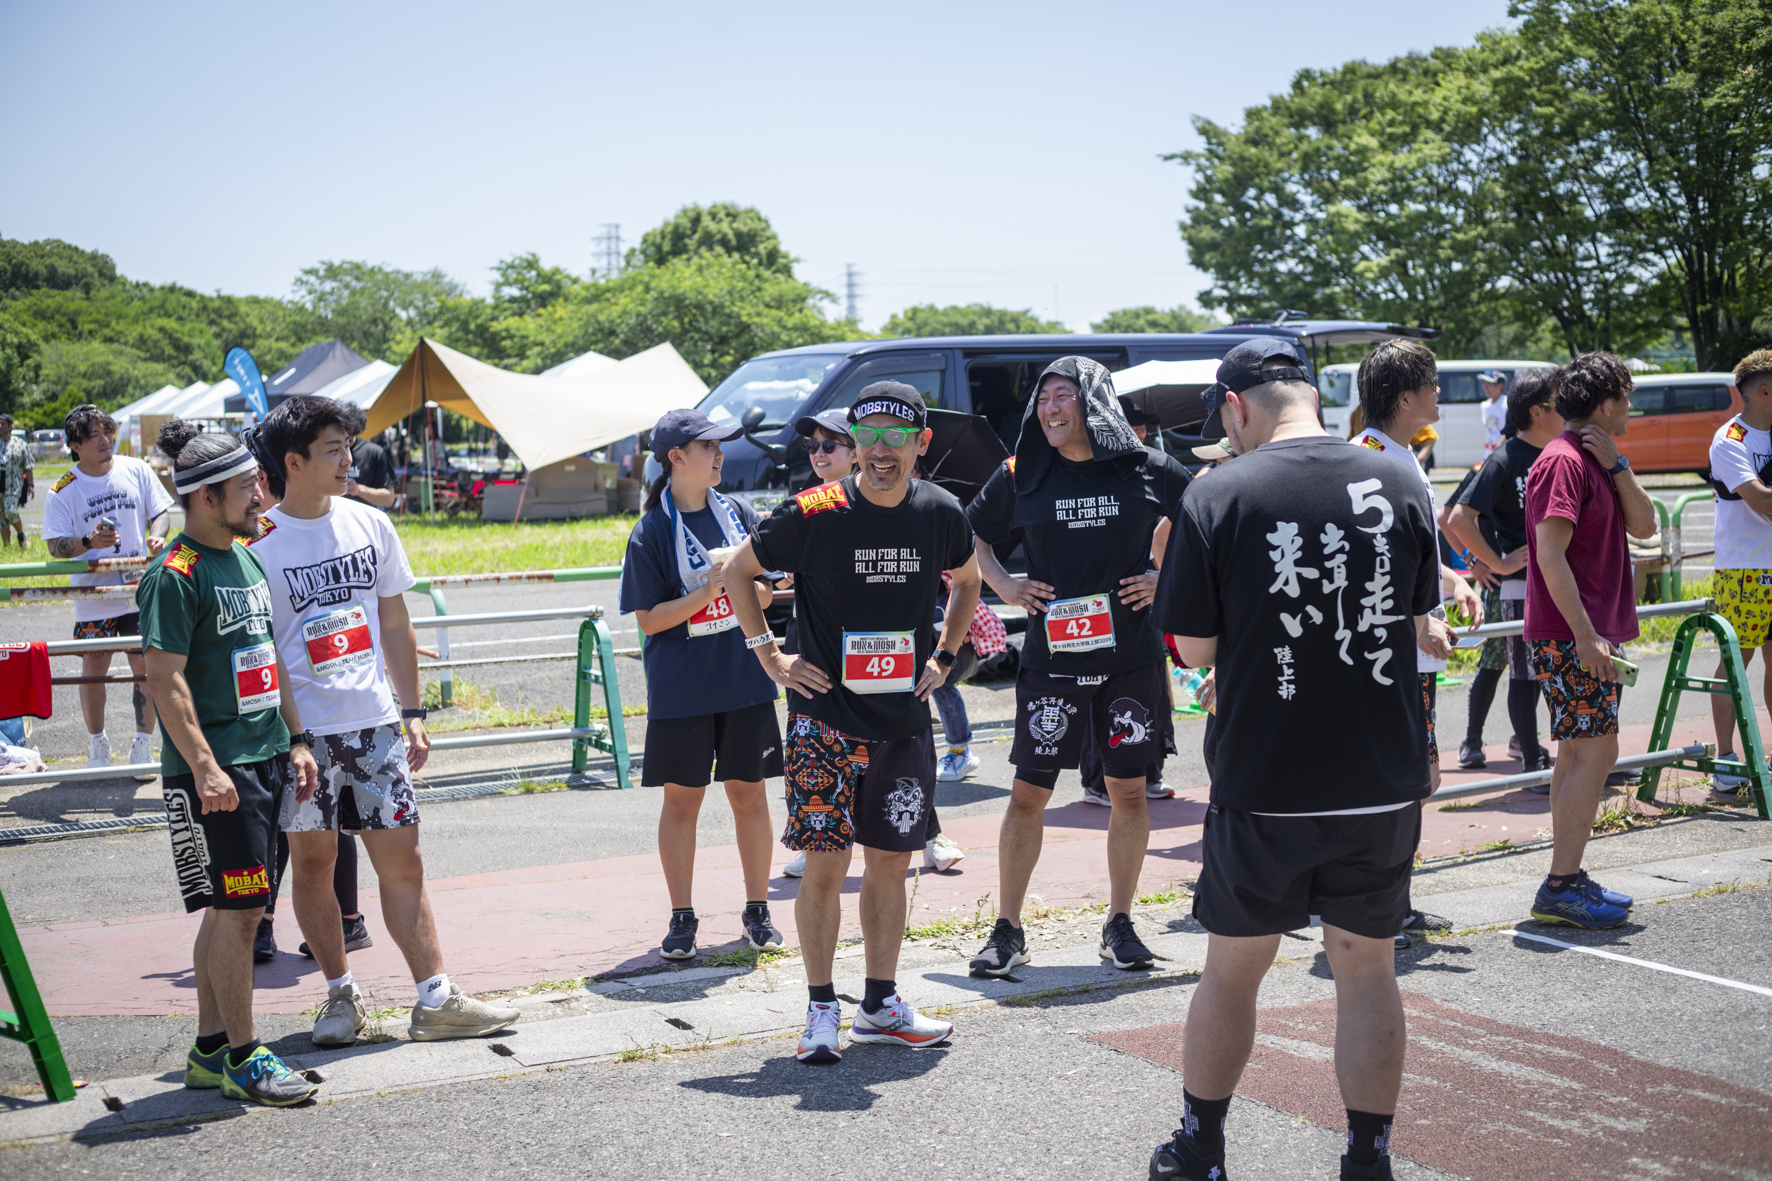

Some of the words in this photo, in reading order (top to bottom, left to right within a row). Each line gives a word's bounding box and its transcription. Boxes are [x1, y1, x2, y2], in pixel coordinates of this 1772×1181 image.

[853, 401, 915, 422] MOBSTYLES
[798, 484, 845, 512] MOBAT
[814, 501, 835, 511] TOKYO
[1055, 498, 1076, 510] RUN
[1077, 496, 1096, 508] FOR
[1098, 495, 1120, 506] ALL,
[1056, 509, 1076, 521] ALL
[1078, 507, 1097, 519] FOR
[1098, 505, 1119, 517] RUN
[1068, 518, 1106, 529] MOBSTYLES
[854, 549, 877, 561] RUN
[878, 548, 898, 560] FOR
[900, 548, 922, 560] ALL,
[855, 562, 875, 573] ALL
[877, 561, 898, 573] FOR
[900, 560, 920, 572] RUN
[283, 545, 377, 612] MOBSTYLES
[866, 574, 907, 583] MOBSTYLES
[1266, 521, 1323, 638] 来い
[316, 587, 351, 606] TOKYO
[705, 597, 730, 618] 48
[1066, 618, 1093, 637] 42
[333, 633, 349, 654] 9
[316, 662, 338, 673] &MOSH
[866, 656, 895, 677] 49
[1273, 645, 1296, 700] 陸上部
[261, 668, 272, 690] 9
[241, 697, 261, 707] &MOSH
[223, 868, 269, 893] MOBAT
[237, 887, 260, 896] TOKYO
